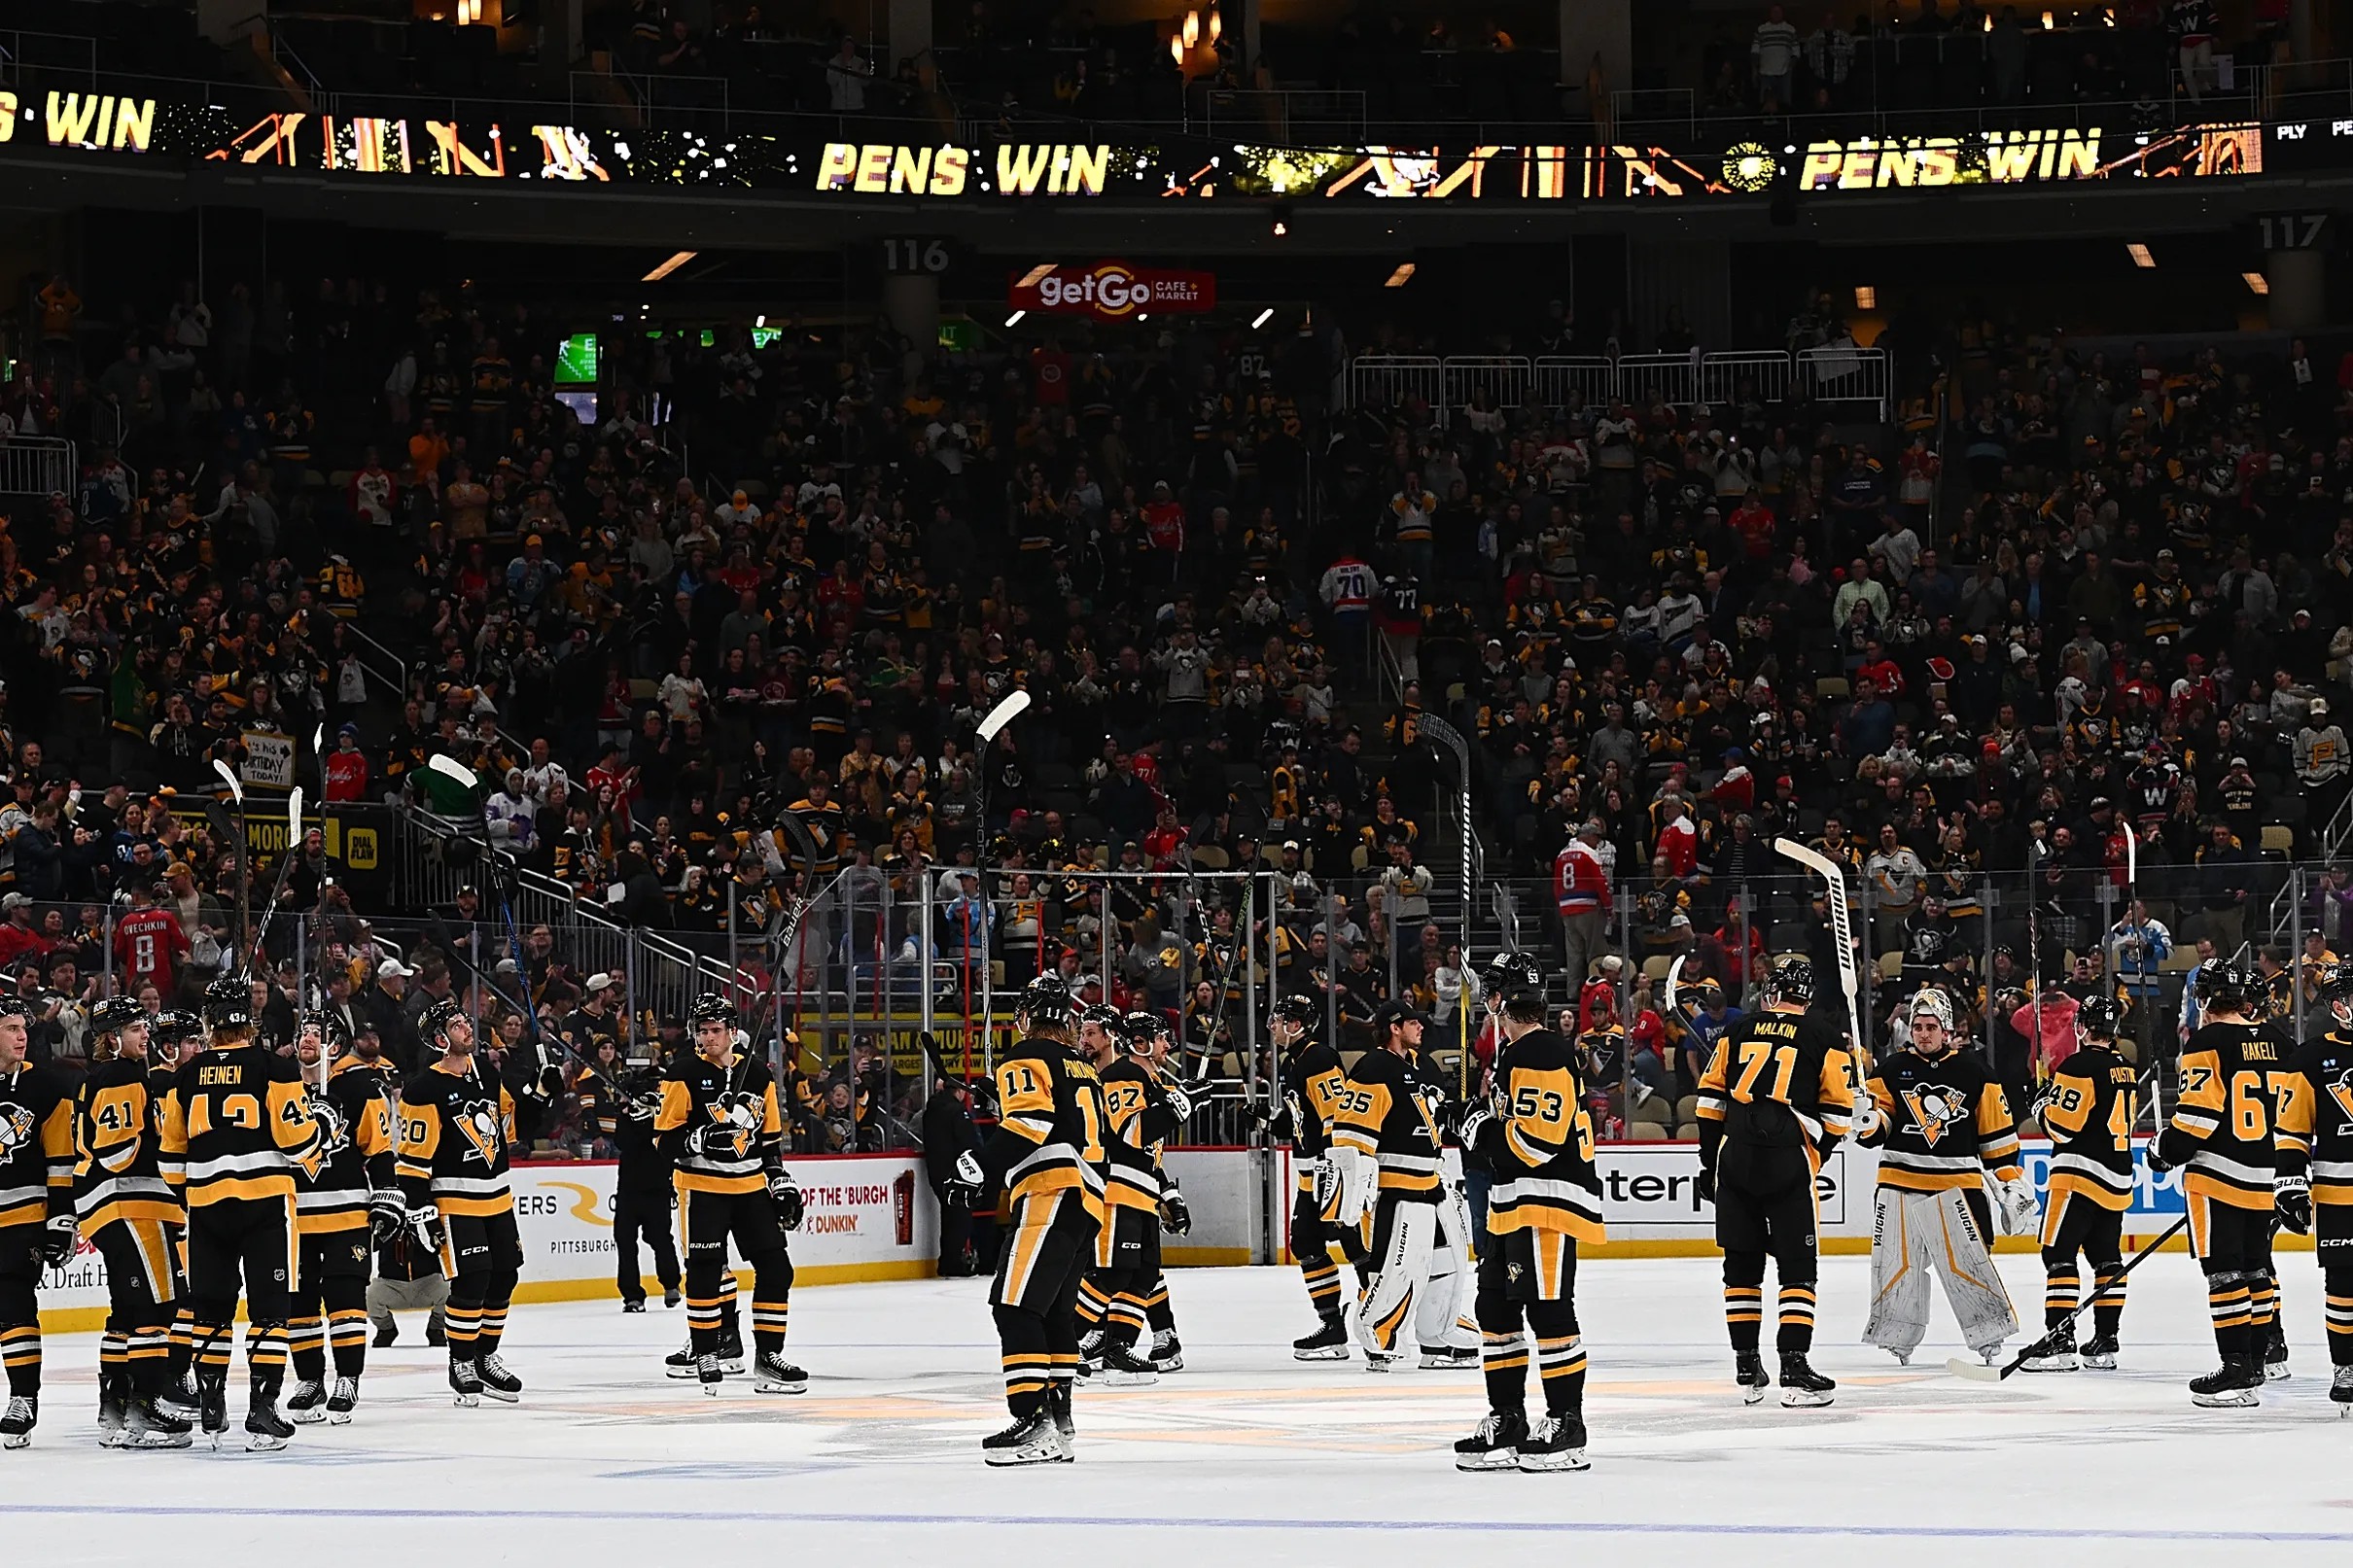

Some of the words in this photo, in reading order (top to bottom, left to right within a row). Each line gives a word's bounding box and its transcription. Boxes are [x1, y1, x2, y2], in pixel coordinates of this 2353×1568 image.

[2180, 16, 2199, 32] W
[47, 90, 156, 152] WIN
[2277, 123, 2307, 140] PLY
[816, 143, 966, 195] PENS
[996, 144, 1109, 194] WIN
[1800, 138, 1958, 192] PENS
[1981, 127, 2101, 182] WIN
[2259, 214, 2329, 250] 117
[884, 239, 950, 272] 116
[1039, 273, 1150, 307] getGo
[1155, 280, 1187, 292] CAFE
[1155, 292, 1199, 301] MARKET
[1240, 356, 1263, 376] 87
[1337, 575, 1366, 599] 70
[1394, 588, 1418, 610] 77
[263, 742, 277, 753] his
[251, 770, 283, 782] TODAY!
[2142, 787, 2167, 807] W
[352, 835, 372, 849] DIAL
[1562, 862, 1575, 889] 8
[123, 920, 167, 935] OVECHKIN
[1196, 898, 1212, 944] CCM
[1828, 875, 1851, 970] WARRIOR
[135, 934, 156, 973] 8
[1797, 984, 1808, 994] 71
[1045, 1007, 1062, 1020] 11
[1637, 1021, 1647, 1030] 8
[1753, 1021, 1798, 1040] MALKIN
[2241, 1041, 2278, 1062] RAKELL
[198, 1064, 242, 1086] HEINEN
[1003, 1067, 1036, 1098] 11
[1730, 1041, 1800, 1106] 71
[2177, 1069, 2212, 1096] 67
[1107, 1087, 1140, 1115] 87
[1317, 1077, 1345, 1102] 15
[2049, 1084, 2082, 1112] 48
[279, 1097, 316, 1126] 43
[1338, 1090, 1373, 1115] 35
[1515, 1086, 1563, 1124] 53
[97, 1100, 135, 1132] 41
[400, 1119, 429, 1144] 20
[1322, 1158, 1336, 1202] VAUGHN
[512, 1196, 557, 1215] ERS
[801, 1188, 816, 1206] OF
[819, 1187, 842, 1205] THE
[845, 1185, 888, 1205] 'BURGH
[816, 1214, 859, 1234] DUNKIN'
[1873, 1202, 1887, 1248] VAUGHN
[1954, 1198, 1979, 1242] VAUGHN
[550, 1239, 616, 1254] PITTSBURGH
[1394, 1221, 1410, 1268] VAUGHN
[2320, 1238, 2353, 1247] CCM
[53, 1264, 93, 1290] Draft
[1358, 1272, 1385, 1322] VAUGHN
[2044, 1304, 2085, 1342] CCM
